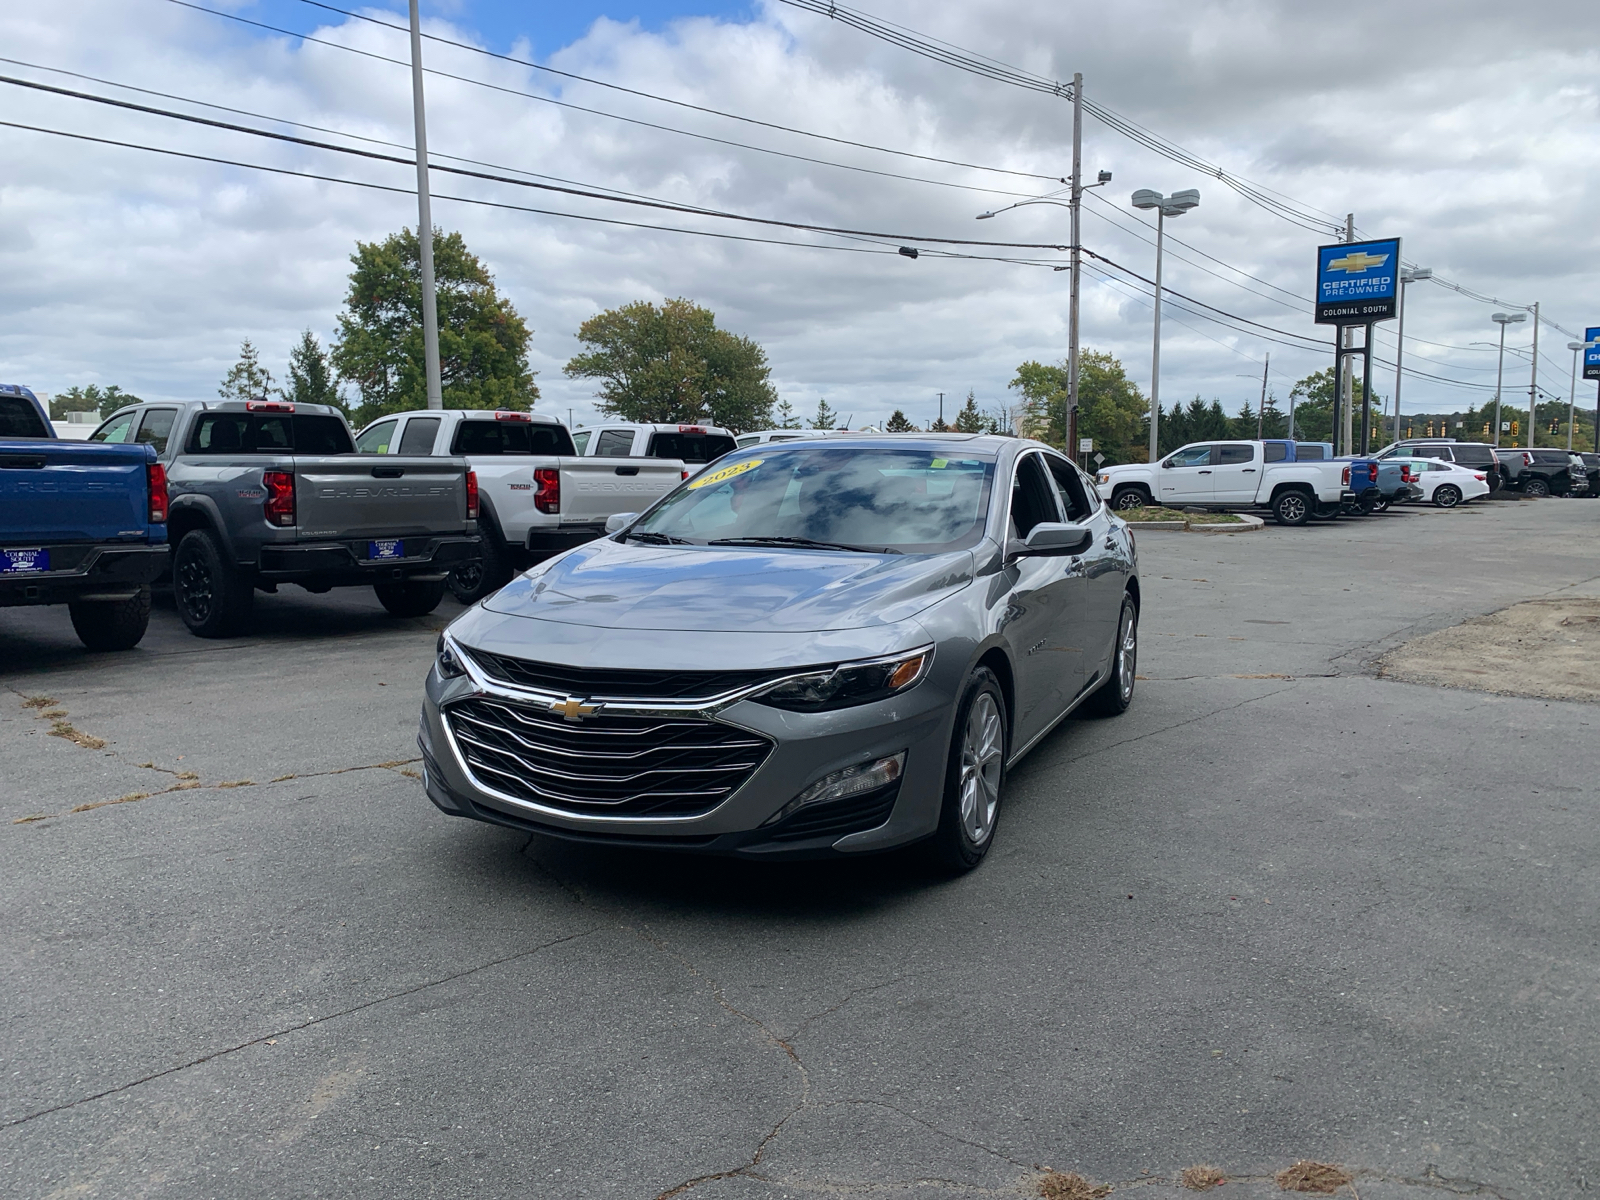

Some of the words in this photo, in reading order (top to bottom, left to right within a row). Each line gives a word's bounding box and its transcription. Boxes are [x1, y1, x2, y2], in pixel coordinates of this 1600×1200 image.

[1322, 276, 1391, 290] CERTIFIED
[1325, 285, 1387, 297] PRE-OWNED
[1323, 308, 1359, 317] COLONIAL
[1363, 305, 1388, 314] SOUTH
[702, 462, 751, 486] 2023
[319, 486, 454, 499] CHEVROLET
[577, 482, 673, 492] CHEVROLET
